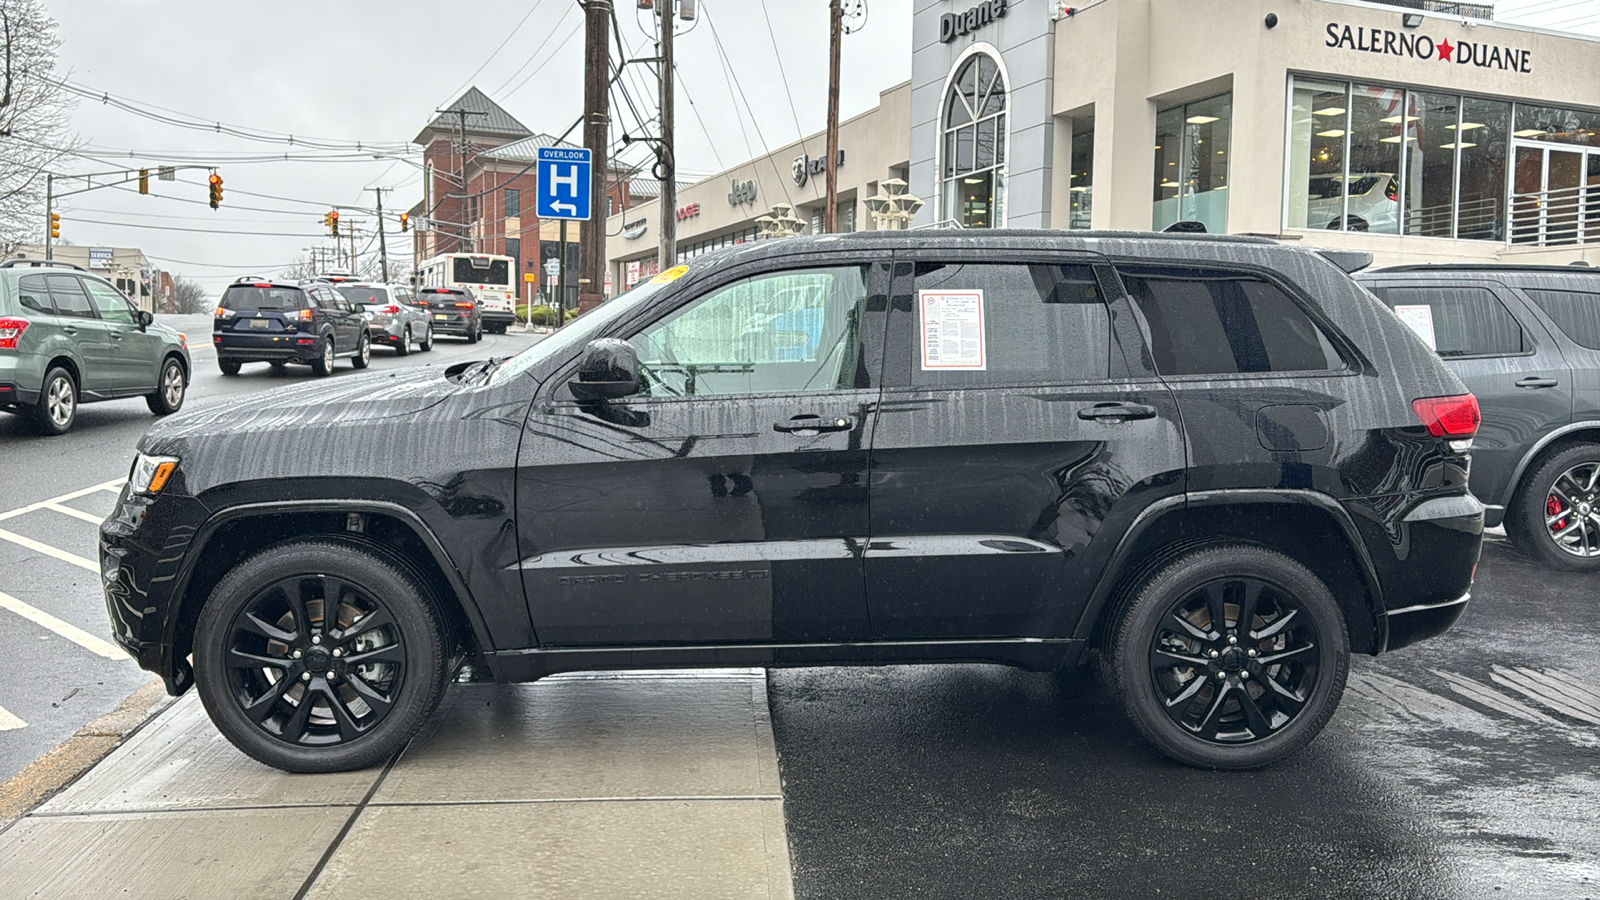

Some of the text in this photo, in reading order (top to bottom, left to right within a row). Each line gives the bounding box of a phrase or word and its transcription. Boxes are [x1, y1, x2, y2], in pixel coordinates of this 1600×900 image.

[940, 0, 1007, 43] Duane
[1325, 22, 1532, 73] SALERNO DUANE
[543, 150, 585, 159] OVERLOOK
[550, 164, 578, 198] H
[728, 179, 756, 207] Jeep
